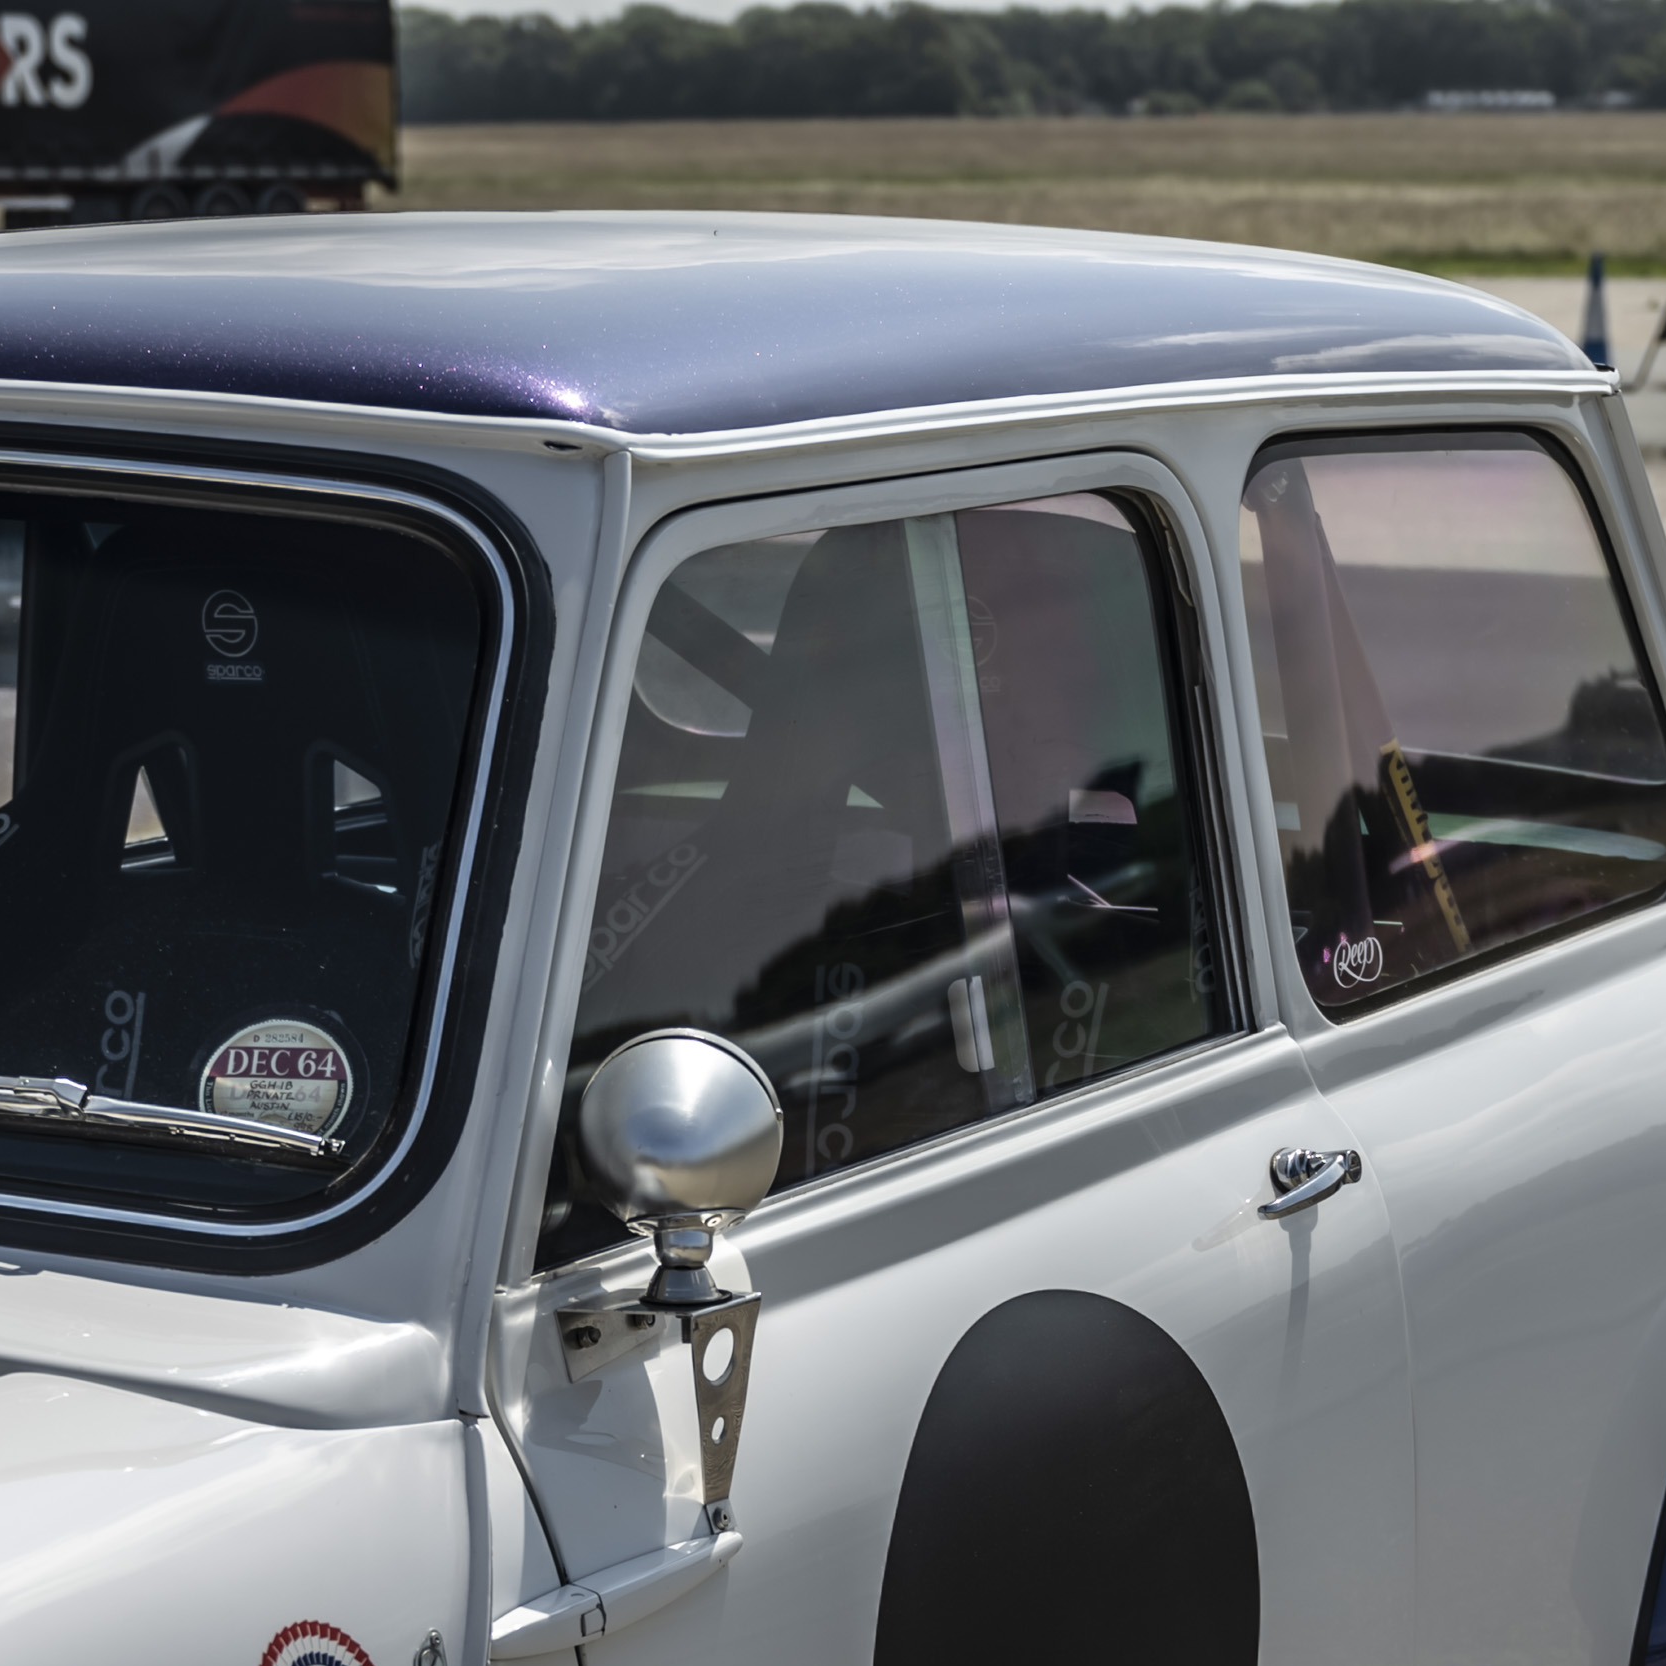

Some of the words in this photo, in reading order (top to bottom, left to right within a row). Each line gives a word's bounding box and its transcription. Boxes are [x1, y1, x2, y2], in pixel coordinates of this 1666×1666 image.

[206, 664, 262, 680] sparco
[225, 1049, 291, 1076] DEC
[297, 1050, 337, 1078] 64
[817, 962, 865, 1160] sparc
[246, 1090, 295, 1100] PRIVATE
[249, 1101, 290, 1111] AUSTIN
